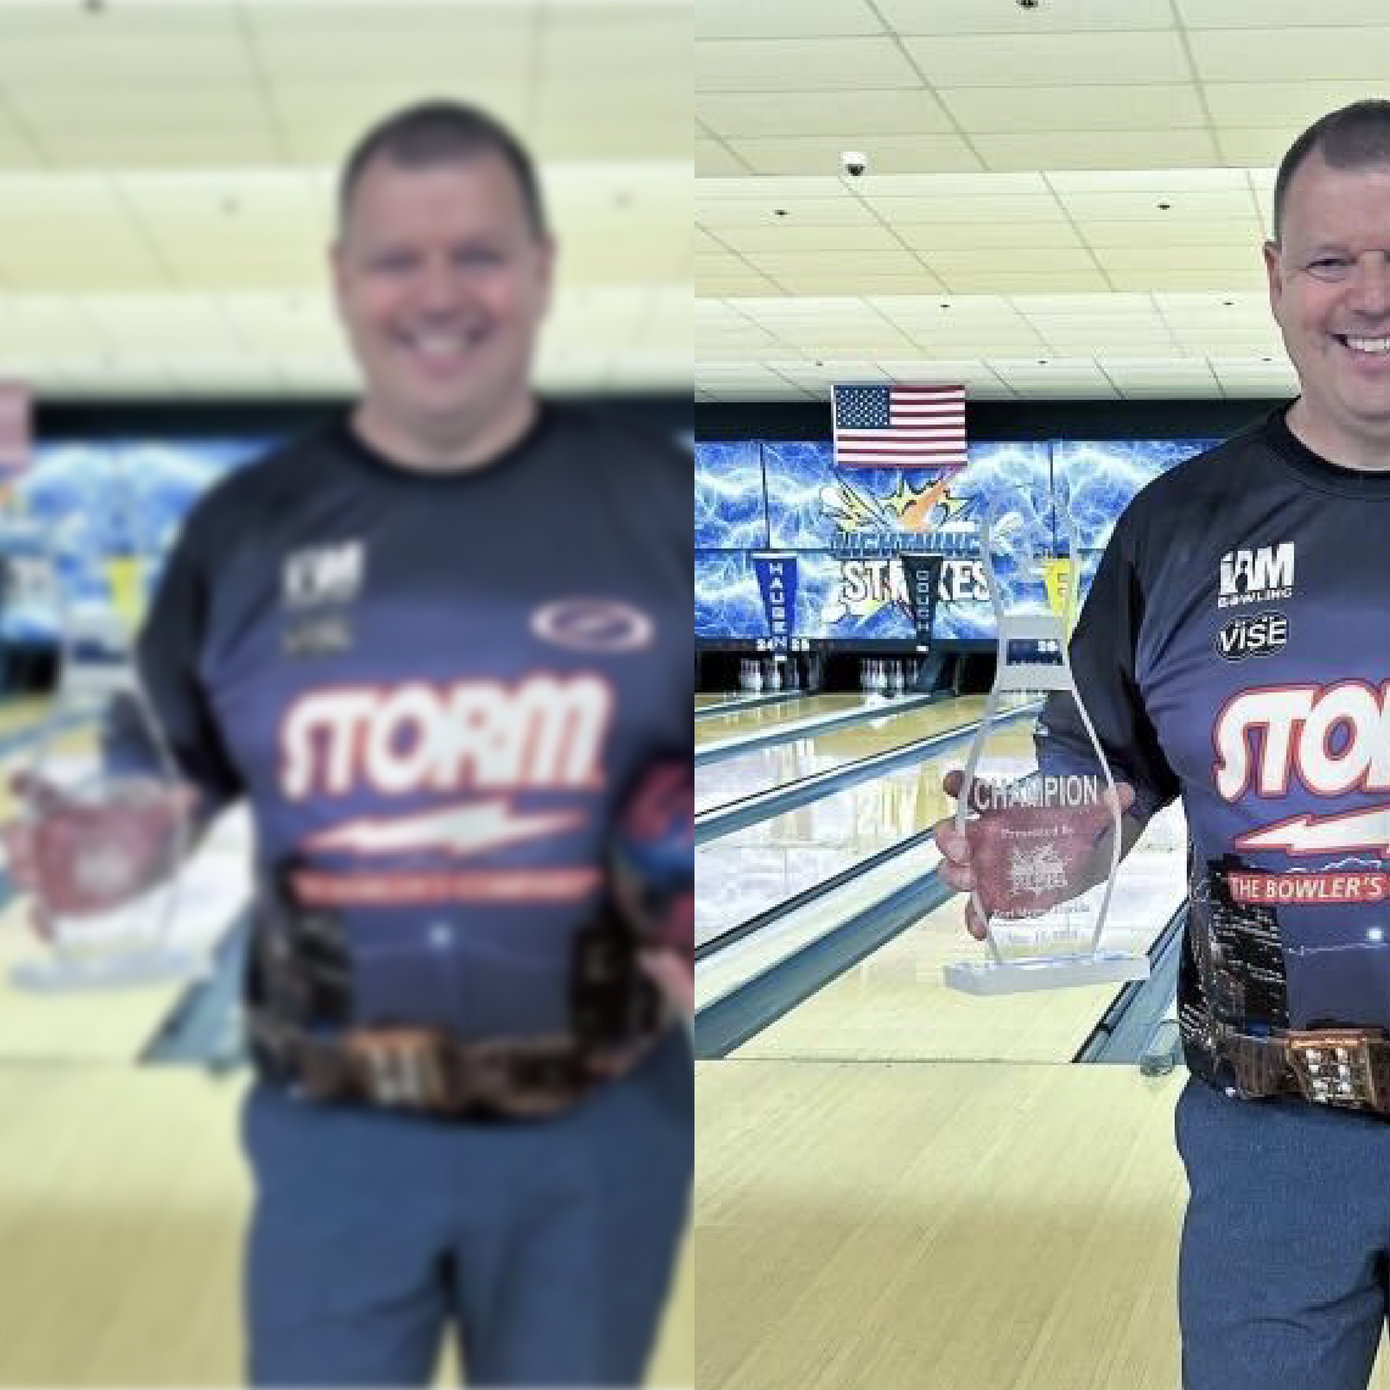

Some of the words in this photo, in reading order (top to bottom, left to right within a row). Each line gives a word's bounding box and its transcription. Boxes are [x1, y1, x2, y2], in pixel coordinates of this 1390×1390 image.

[973, 774, 1098, 810] CHAMPION
[1231, 876, 1260, 899] THE
[1265, 873, 1382, 899] BOWLER'S
